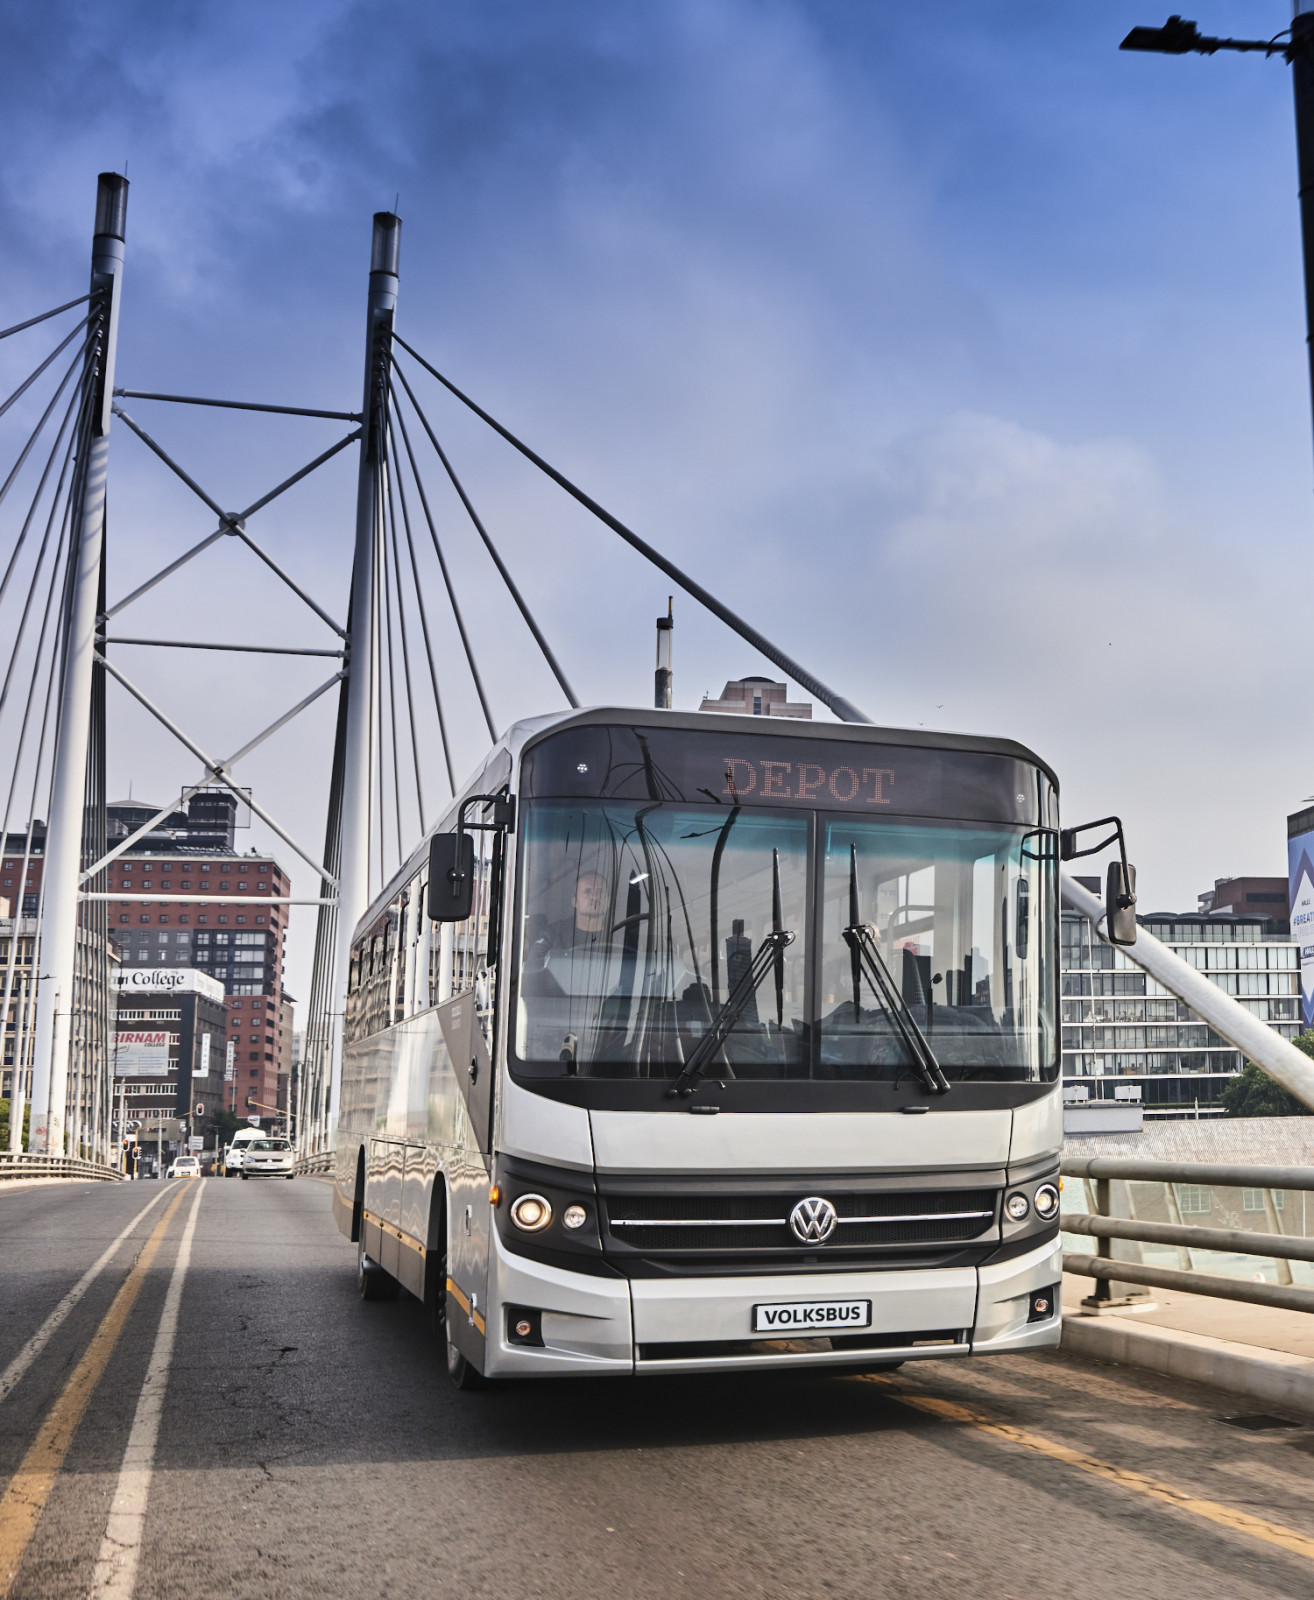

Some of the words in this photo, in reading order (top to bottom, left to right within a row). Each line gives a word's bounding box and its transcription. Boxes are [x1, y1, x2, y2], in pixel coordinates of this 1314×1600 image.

[722, 757, 895, 804] DEPOT
[132, 970, 185, 990] College
[110, 1032, 166, 1043] BIRNAM
[764, 1306, 861, 1325] VOLKSBUS
